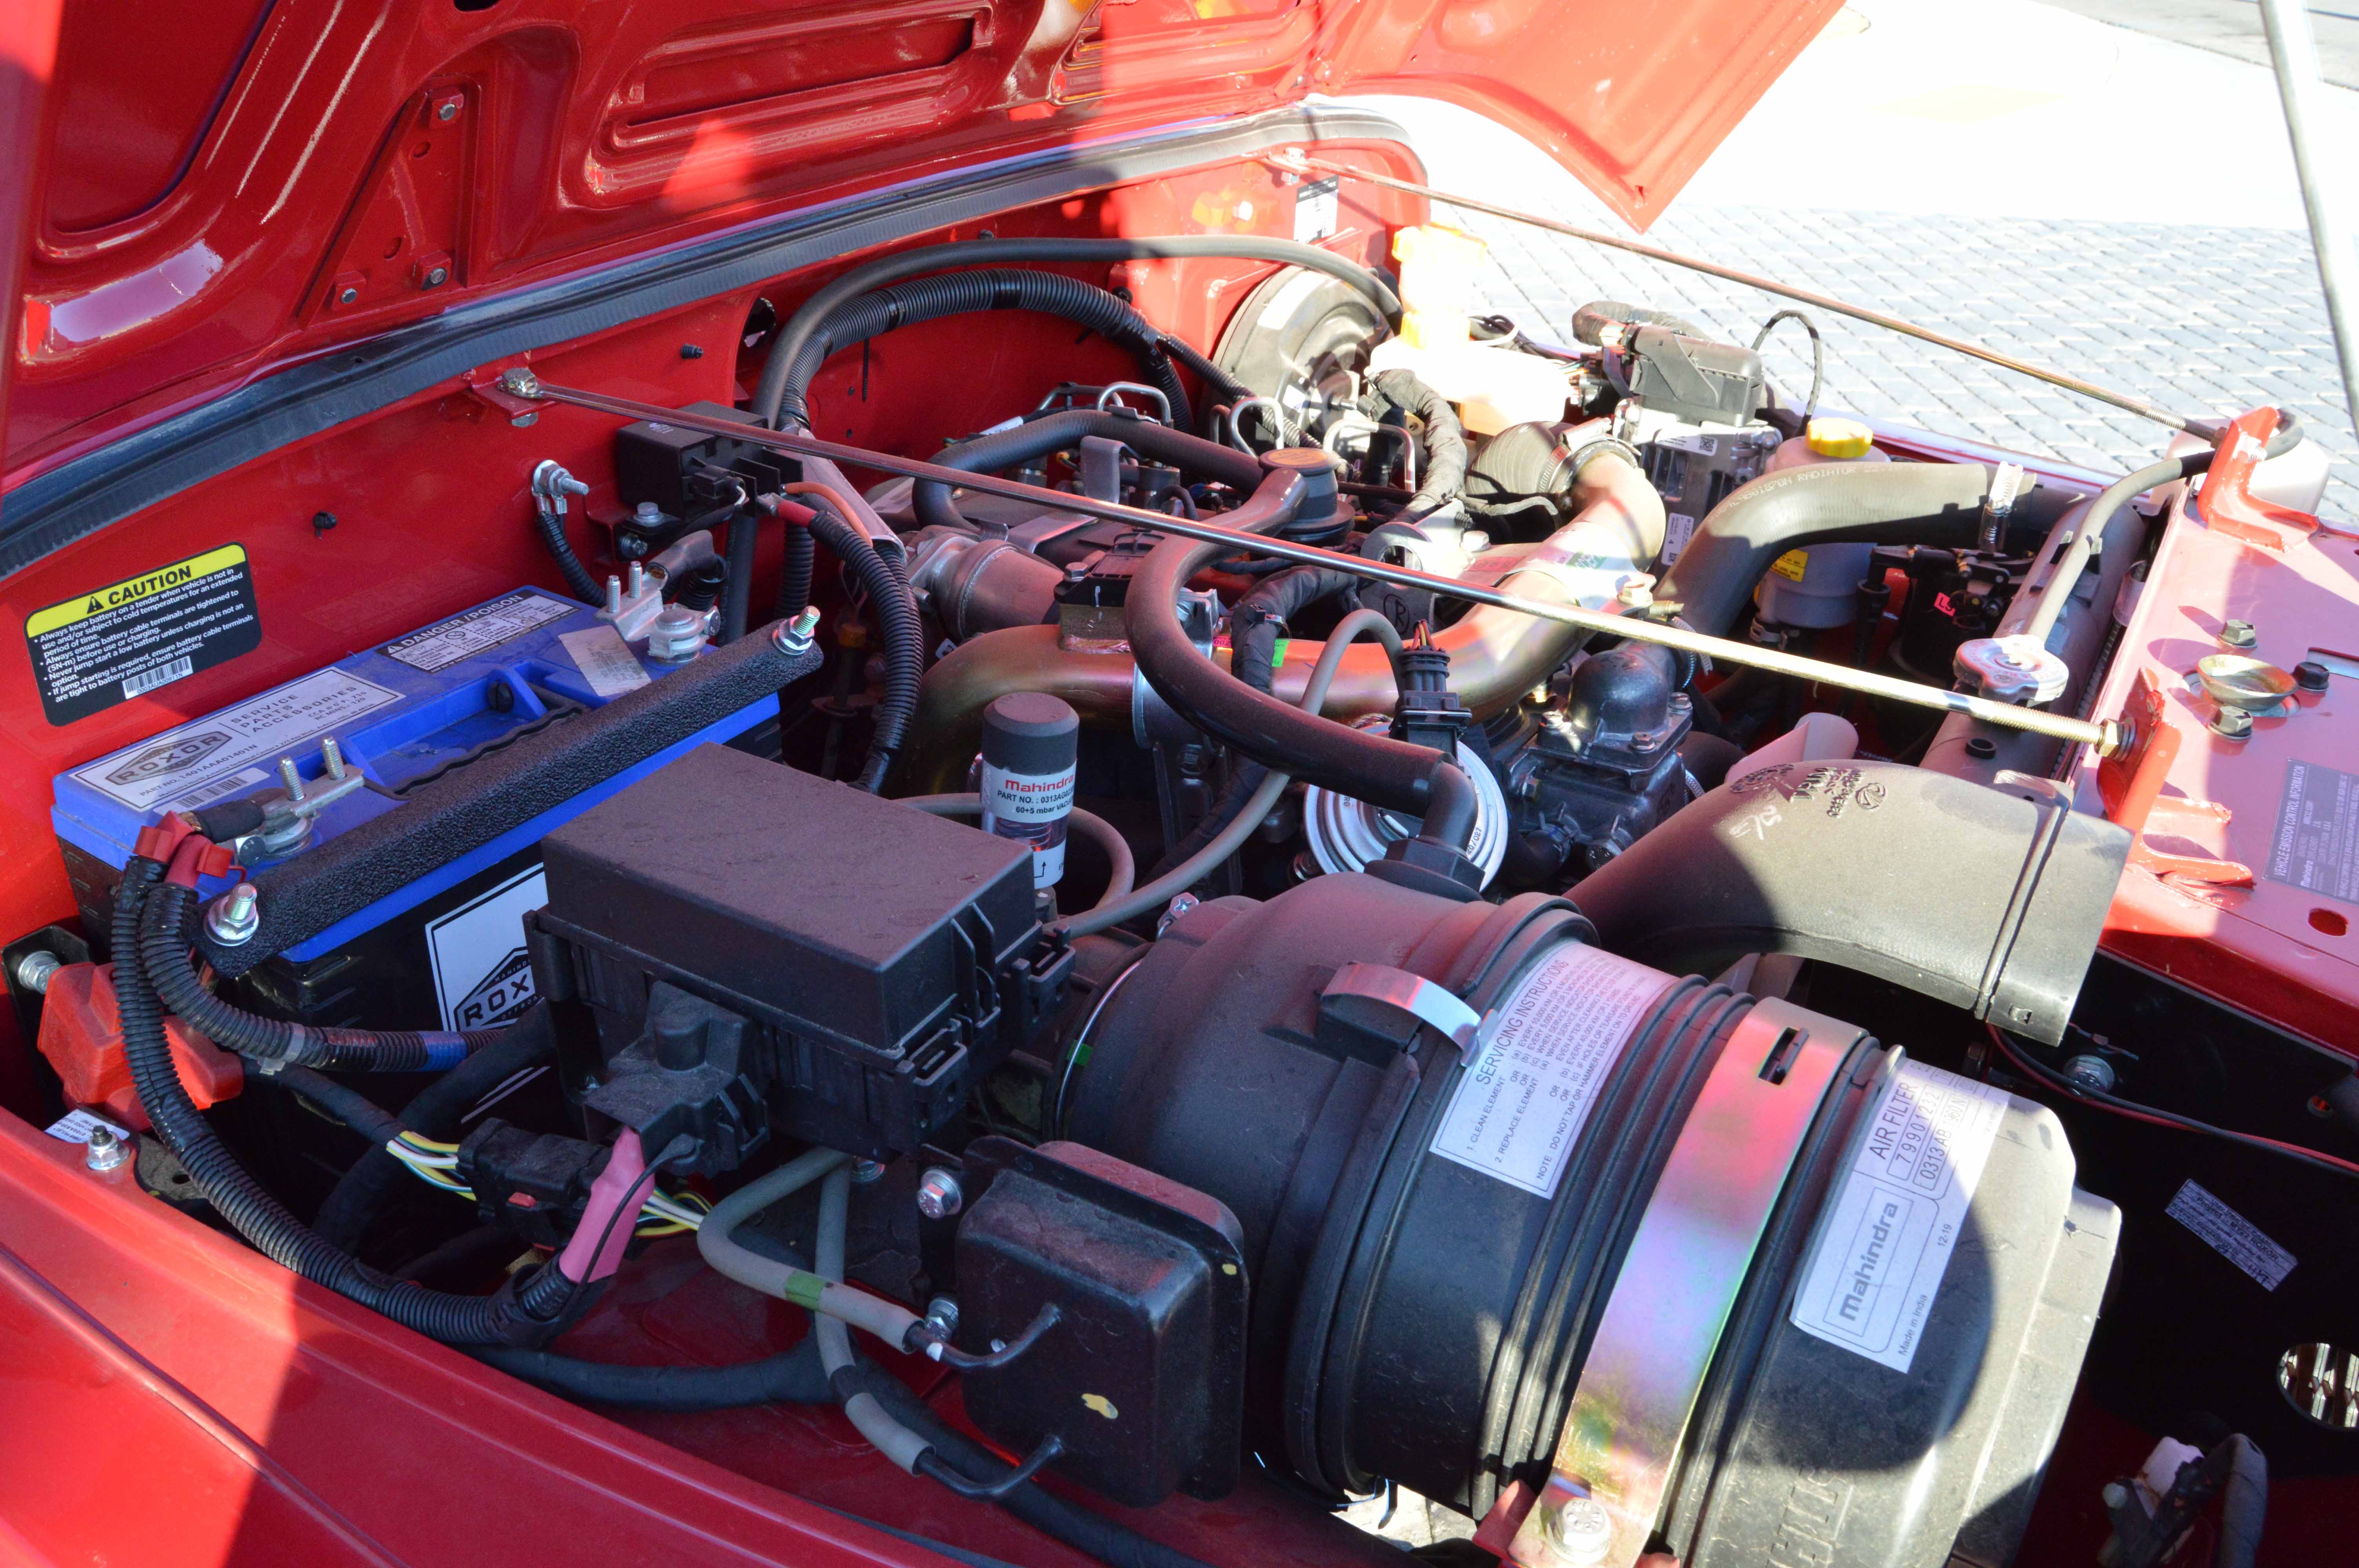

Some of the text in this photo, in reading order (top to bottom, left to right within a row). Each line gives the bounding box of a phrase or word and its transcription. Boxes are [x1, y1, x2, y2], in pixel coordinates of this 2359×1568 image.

[1797, 466, 1857, 482] RADIATOR
[39, 570, 226, 644] Always keep battery tender when vehicle not
[107, 564, 193, 607] CAUTION
[42, 572, 244, 651] use and/or subject cold temperatures for extended
[45, 592, 231, 667] Always ensure battery cable terminals are tightened
[398, 617, 465, 647] DANGER
[43, 632, 100, 659] period time.
[49, 606, 234, 681] Never jump start low battery unless charging not
[59, 613, 254, 695] jump starting required, ensure battery cable terminals
[76, 647, 103, 662] before
[103, 642, 116, 652] use
[126, 625, 162, 645] charging.
[51, 672, 79, 689] option.
[55, 639, 204, 703] are tight battery posts both vehicles.
[229, 693, 300, 724] SERVICE
[238, 704, 294, 729] PARTS
[248, 685, 360, 733] ACCESSORIES
[306, 708, 326, 718] CCA
[113, 734, 224, 782] ROXOR
[138, 744, 259, 796] PART NO. 1401AAA01401N
[997, 790, 1017, 802] PART
[1005, 775, 1073, 792] Mahindra
[2273, 764, 2306, 877] VEHICLE EMISSION CONTROL INFORMATION
[495, 960, 530, 982] MAHIND
[464, 973, 529, 1028] ROX
[502, 995, 542, 1020] OFFROA
[1474, 958, 1570, 1085] SERVICING INSTRUCTIONS
[1557, 1011, 1578, 1036] SERVICE
[1507, 1069, 1522, 1083] OR
[1519, 1053, 1532, 1064] (b)
[1526, 1028, 1545, 1050] EVERY
[1517, 1073, 1532, 1087] OR
[1529, 1056, 1541, 1067] (c)
[1535, 1033, 1553, 1054] WHEN
[1548, 1008, 1569, 1033] SERVICE
[1538, 1060, 1551, 1071] (a)
[1544, 1036, 1562, 1057] WHEN
[1555, 1042, 1571, 1061] EVEN
[1566, 1023, 1583, 1042] AFTER
[1558, 1088, 1572, 1102] OR
[1569, 1071, 1581, 1082] (c)
[1580, 1039, 1598, 1061] HOLES
[1592, 1029, 1604, 1040] OR
[1469, 1114, 1489, 1143] CLEAN
[1483, 1076, 1507, 1114] ELEMENT
[1510, 1049, 1523, 1060] (a)
[1517, 1025, 1536, 1047] EVERY
[1547, 1084, 1561, 1098] OR
[1558, 1067, 1571, 1078] (b)
[1565, 1042, 1583, 1065] EVERY
[1516, 1077, 1539, 1114] ELEMENT
[1536, 1155, 1552, 1179] NOTE
[1549, 1136, 1561, 1150] DO
[1555, 1116, 1569, 1135] NOT
[1563, 1100, 1576, 1116] TAP
[1570, 1088, 1585, 1101] OR
[1578, 1056, 1600, 1088] HAMMER
[1595, 1029, 1617, 1057] ELEMENT
[1612, 1019, 1623, 1029] ON
[1496, 1115, 1521, 1154] REPLACE
[1866, 1080, 1918, 1161] AIR FILTER
[1837, 1199, 1900, 1322] Mahindra
[1896, 1326, 1917, 1357] Made
[1910, 1292, 1929, 1318] India
[1935, 1221, 1954, 1249] 12-19
